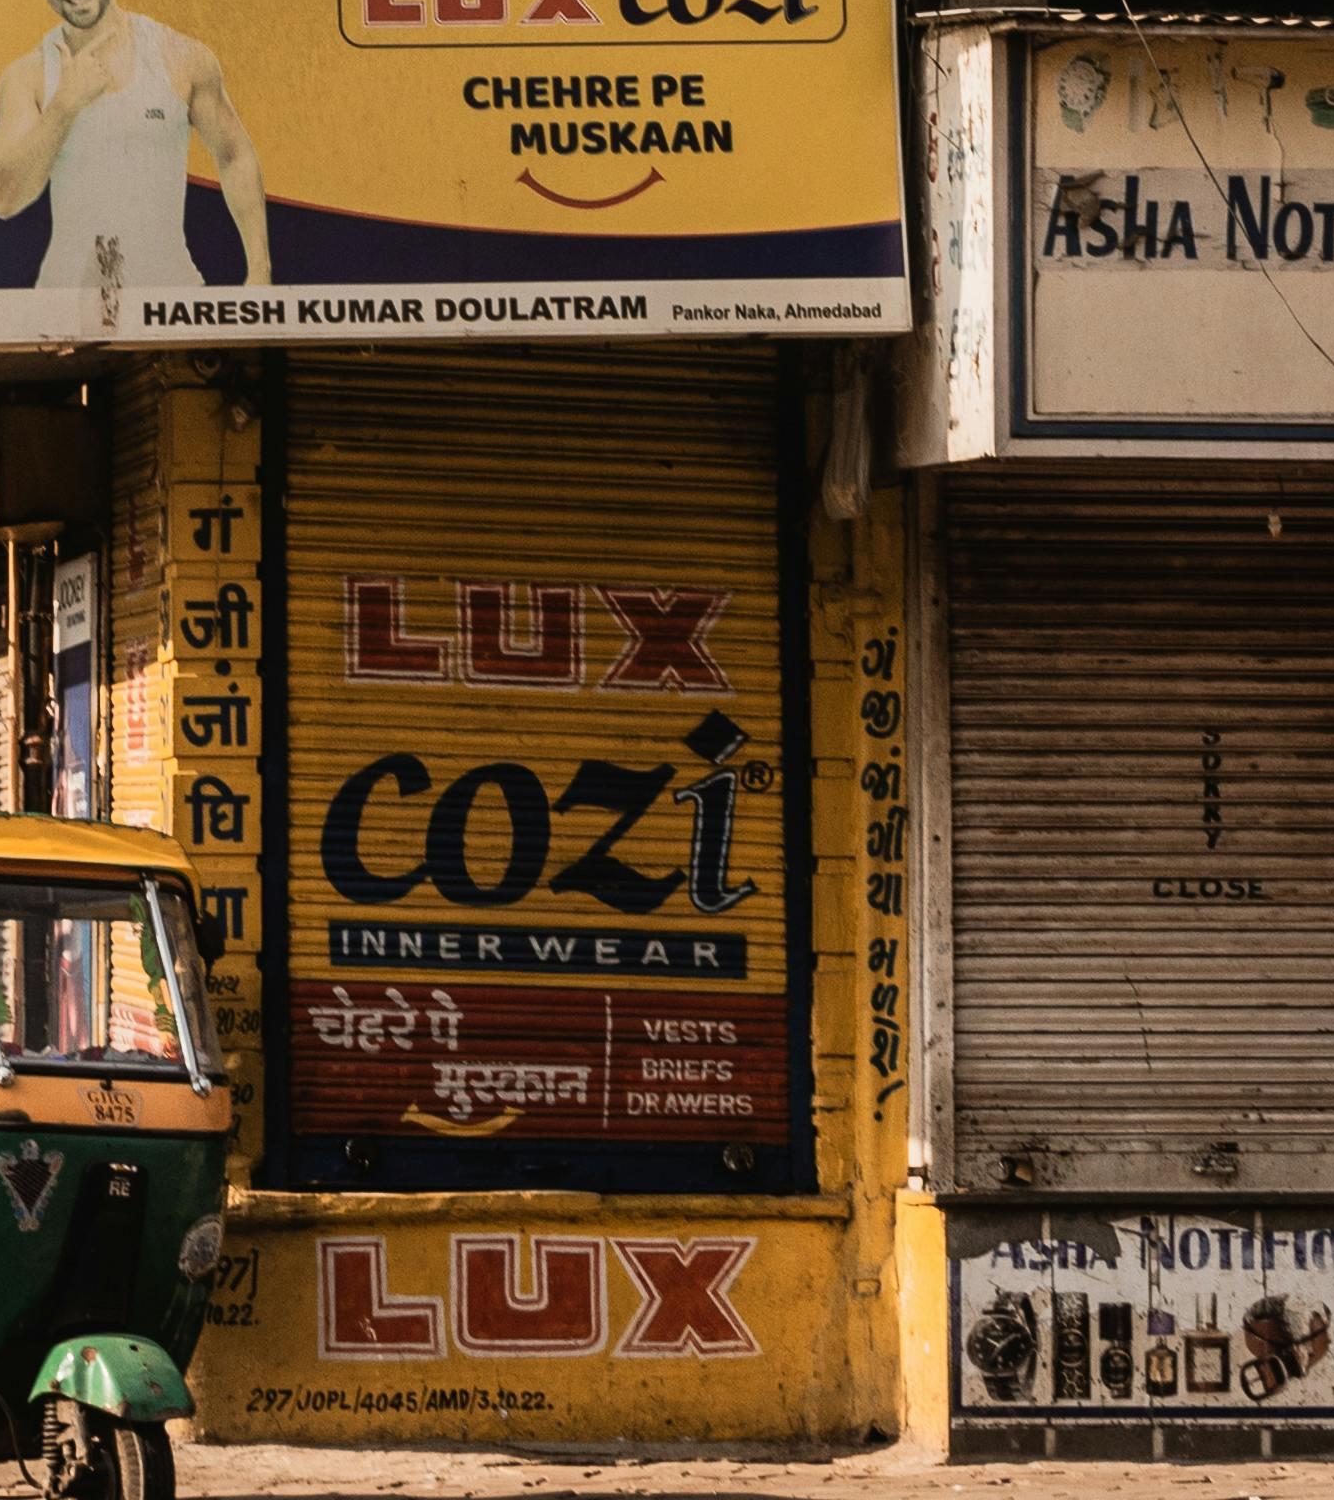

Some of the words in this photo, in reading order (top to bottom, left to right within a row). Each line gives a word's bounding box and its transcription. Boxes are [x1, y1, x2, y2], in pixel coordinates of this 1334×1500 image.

[463, 75, 641, 110] CHEHRE
[652, 73, 706, 107] PE
[509, 120, 734, 156] MUSKAAN
[143, 300, 286, 327] HARESH
[297, 299, 425, 325] KUMAR
[434, 296, 648, 323] DOULATRAM
[671, 303, 731, 322] Pankor
[734, 304, 781, 323] Naka,
[784, 301, 883, 320] Ahmedabad
[343, 574, 737, 698] LUX
[319, 707, 761, 914] cozi
[1152, 876, 1269, 900] CLOSE
[340, 929, 504, 961] INNER
[527, 935, 721, 968] WEAR
[308, 986, 419, 1052] चेहरे
[426, 988, 464, 1051] पे
[642, 1018, 739, 1044] VESTS
[641, 1057, 734, 1083] BRIEFS
[431, 1061, 592, 1120] मुस्कान
[626, 1091, 754, 1116] DRAWERS
[94, 1104, 136, 1124] 8475
[108, 1179, 131, 1197] RE
[315, 1232, 765, 1361] LUX
